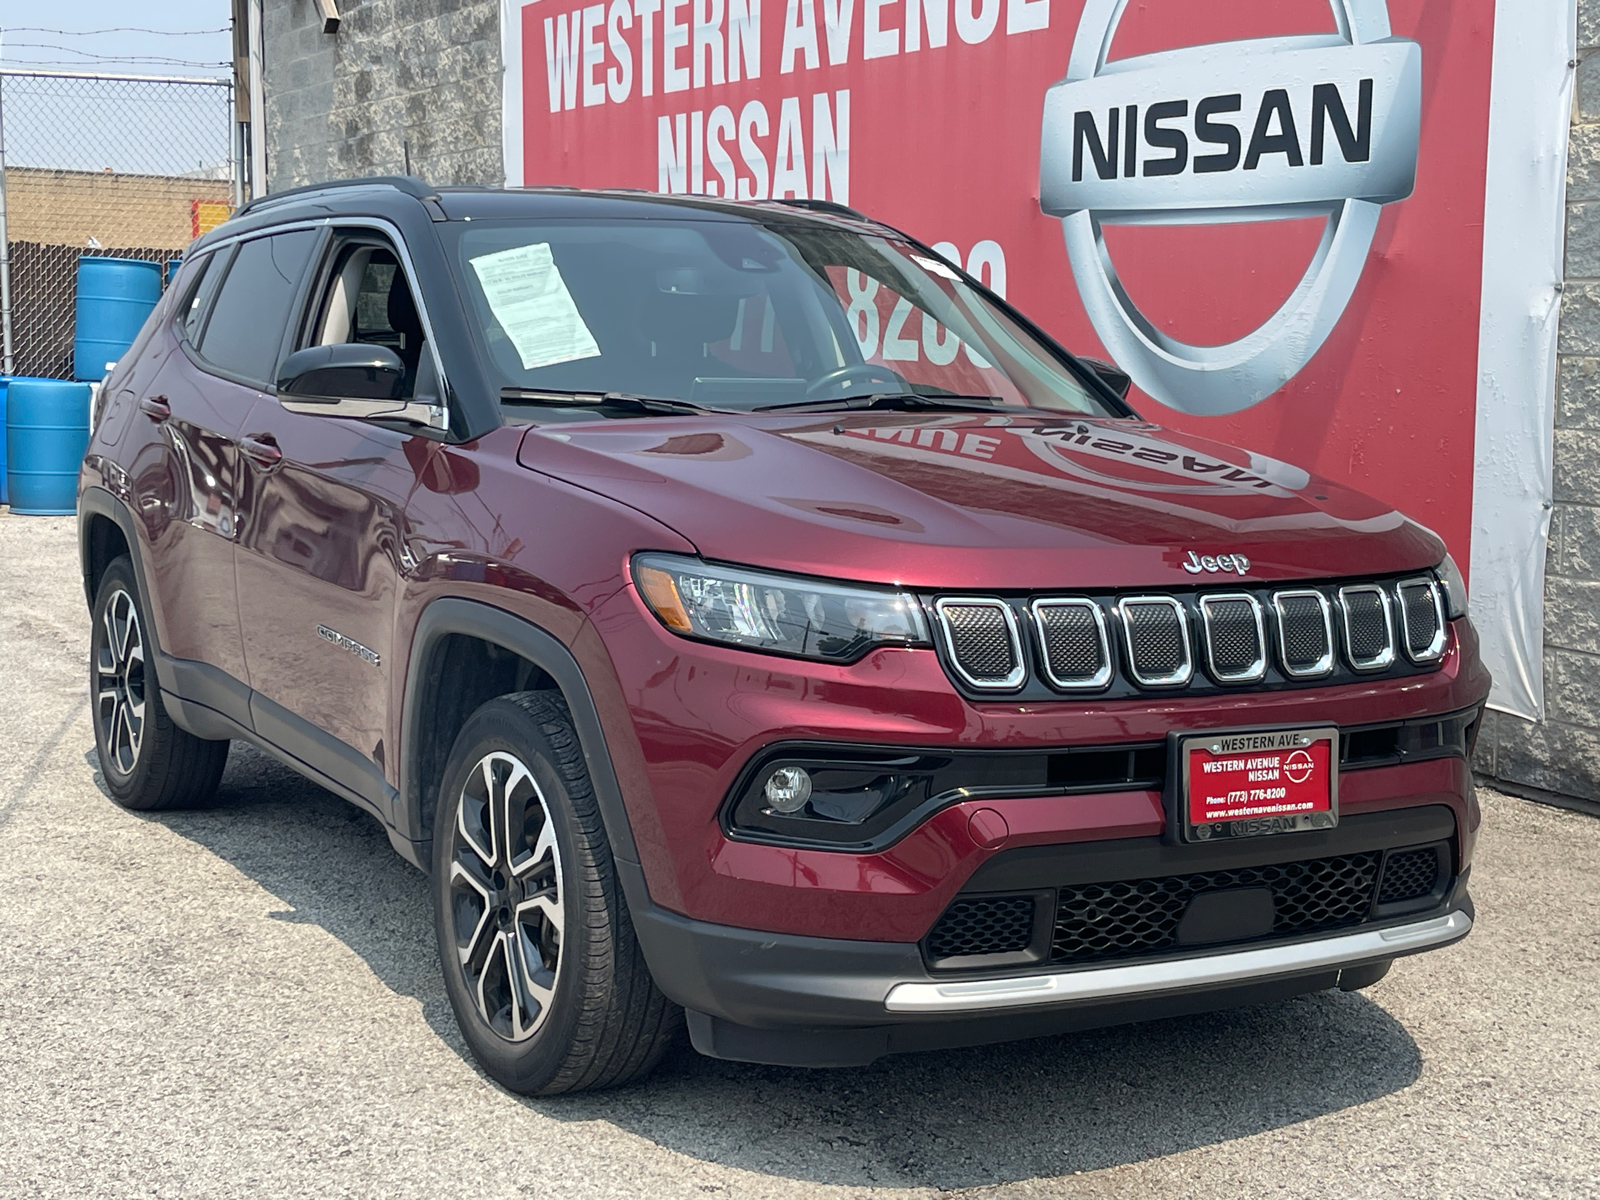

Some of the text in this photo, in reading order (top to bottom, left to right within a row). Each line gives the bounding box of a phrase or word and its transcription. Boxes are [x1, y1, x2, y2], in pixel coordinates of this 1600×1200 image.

[544, 0, 1049, 114] WESTERN AVE
[1071, 78, 1374, 182] NISSAN
[657, 89, 850, 208] NISSAN
[1182, 550, 1250, 576] Jeep
[1221, 735, 1275, 751] WESTERN
[1202, 756, 1280, 773] WESTERN AVENUE
[1283, 762, 1314, 770] NISSAN
[1248, 769, 1280, 782] NISSAN
[1227, 790, 1248, 805] (773)
[1249, 787, 1286, 800] 776-8200
[1206, 802, 1314, 818] www.westernavenissan.com
[1230, 815, 1297, 836] NISSAN
